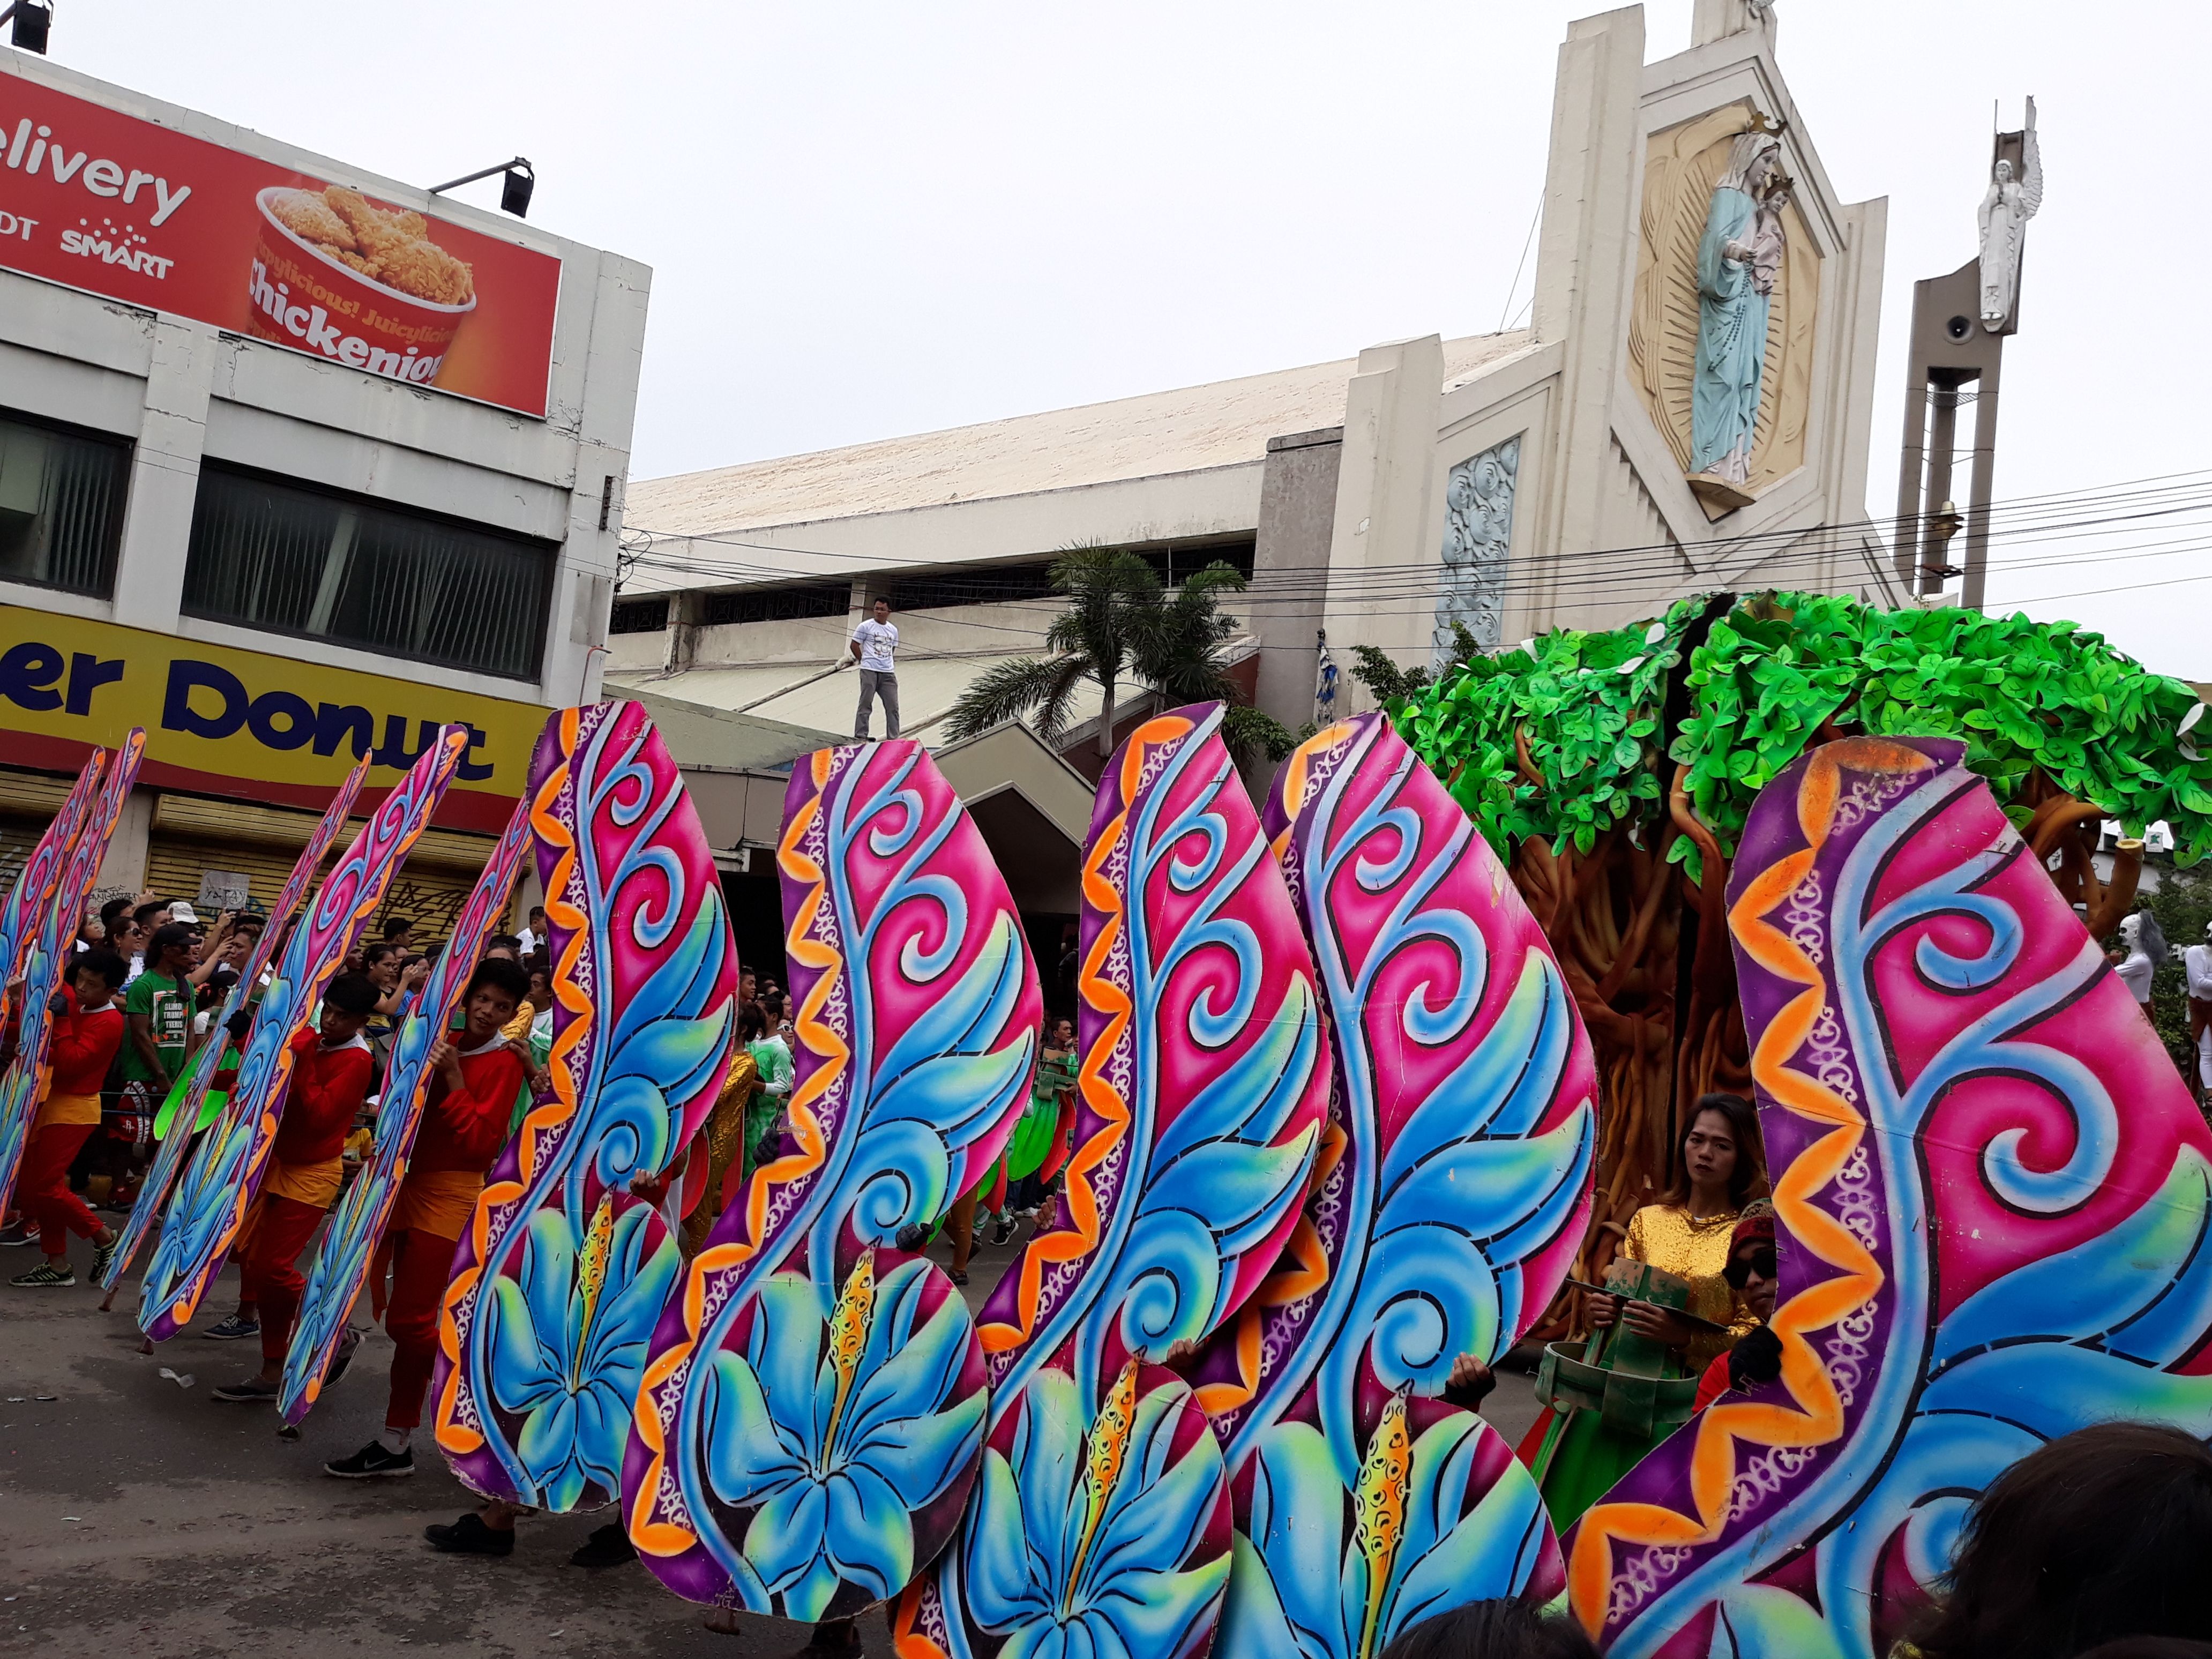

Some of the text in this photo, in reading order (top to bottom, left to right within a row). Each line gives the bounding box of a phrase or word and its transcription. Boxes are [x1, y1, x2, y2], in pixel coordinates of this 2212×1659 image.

[0, 118, 191, 227] livery
[60, 229, 175, 279] SMART
[161, 660, 495, 781] Donut
